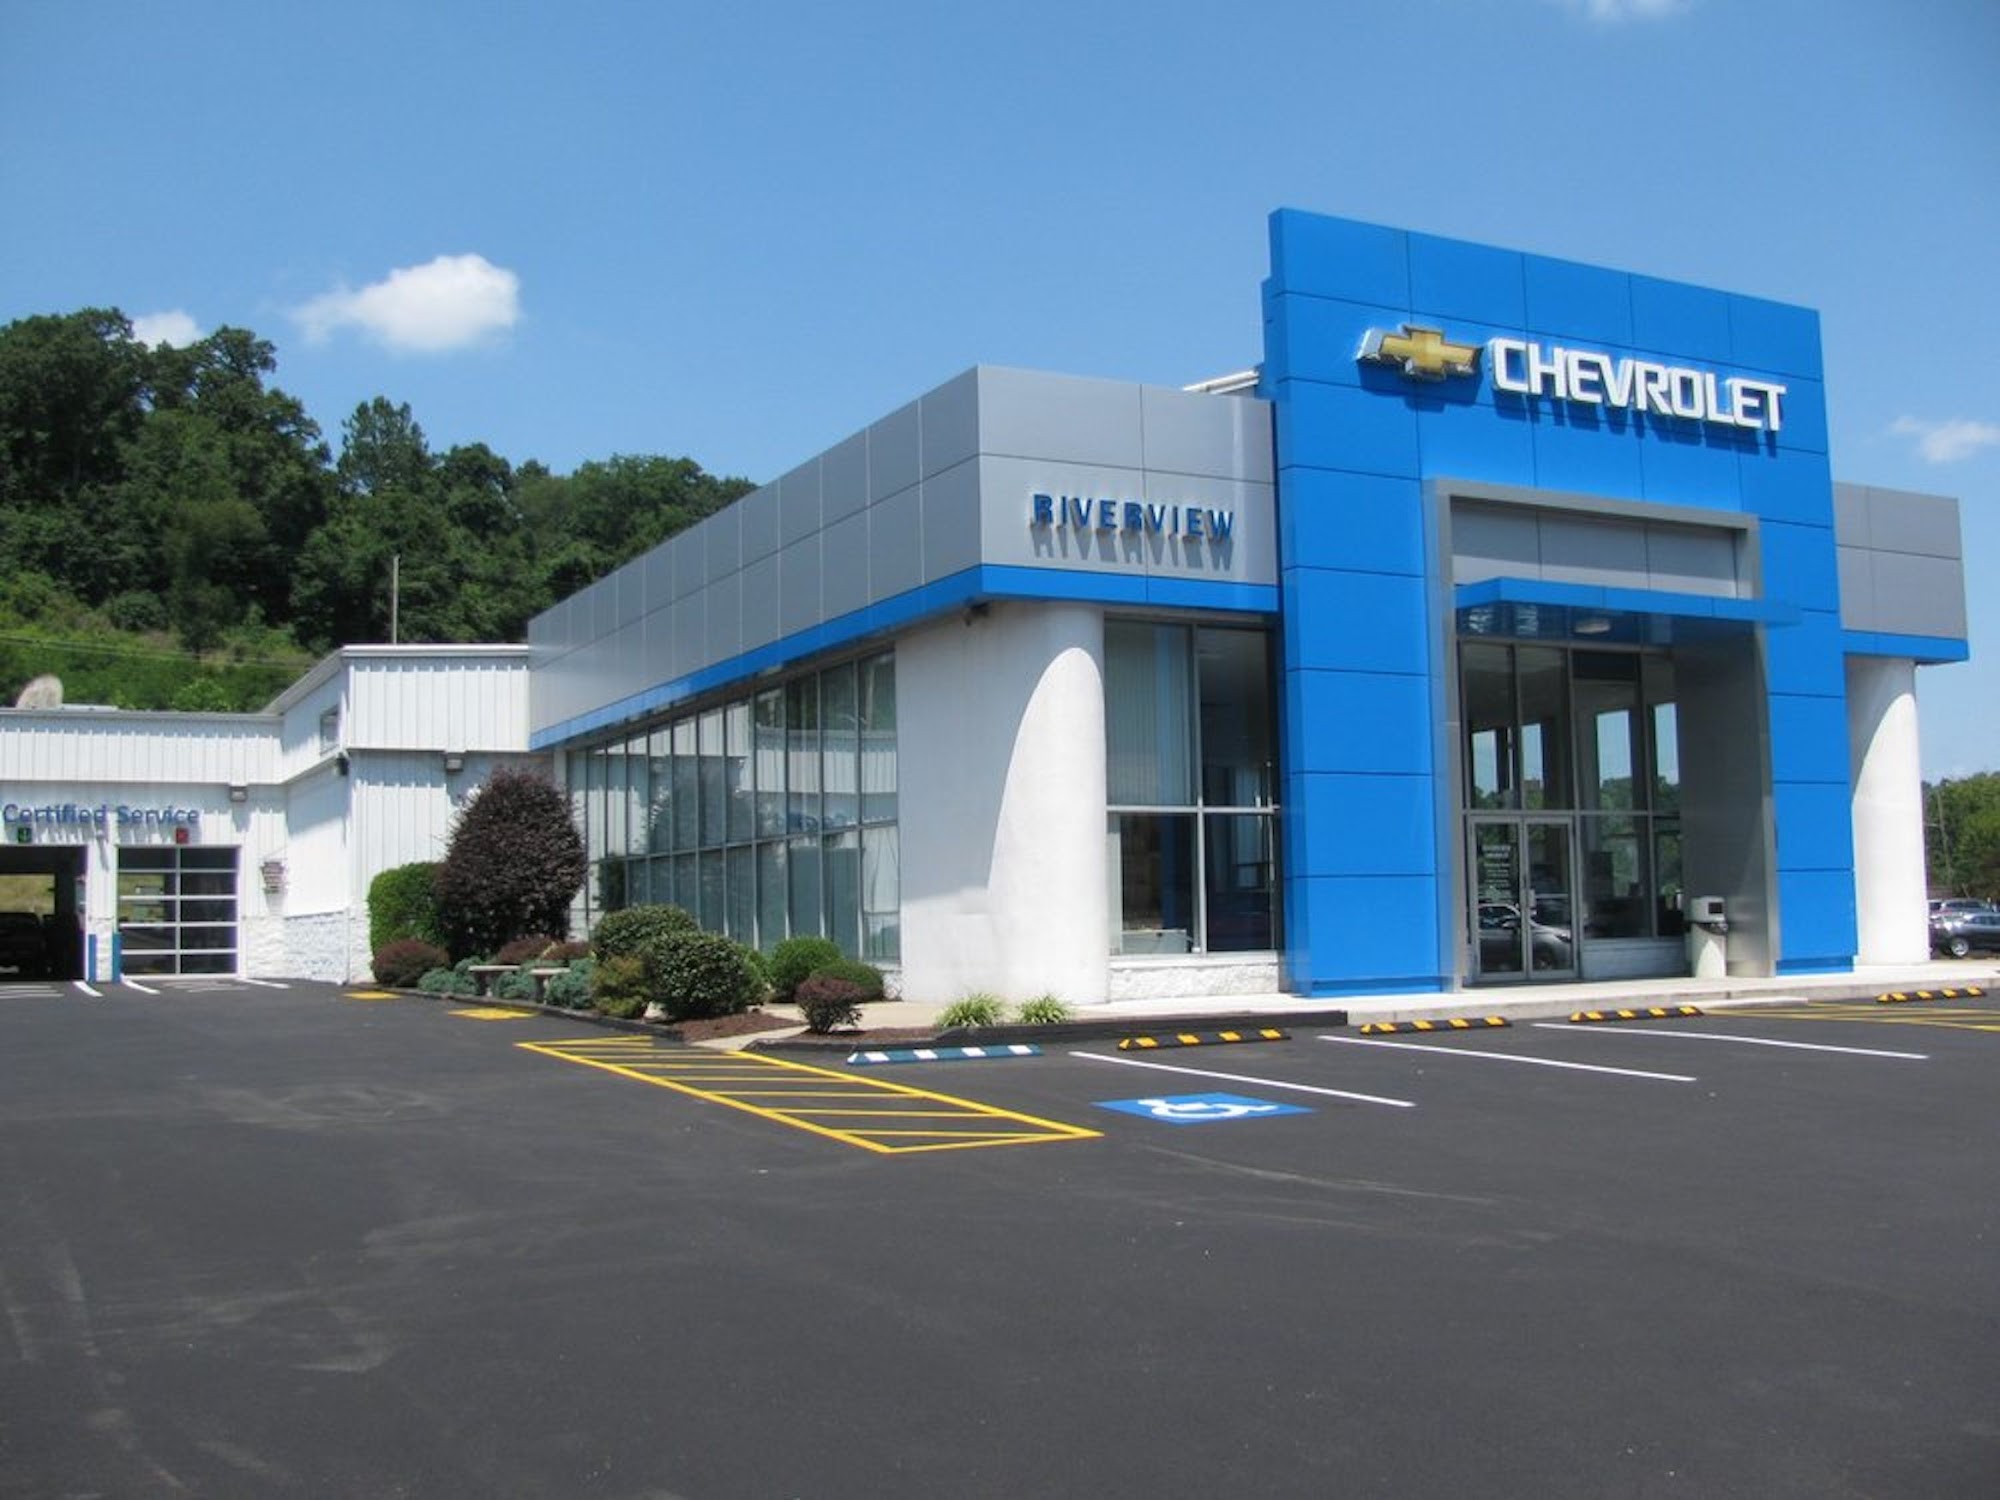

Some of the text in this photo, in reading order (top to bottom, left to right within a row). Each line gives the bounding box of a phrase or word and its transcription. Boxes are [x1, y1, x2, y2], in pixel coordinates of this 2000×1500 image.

[1489, 337, 1786, 431] CHEVROLET
[1033, 494, 1233, 540] RIVERVIEW
[3, 804, 199, 824] Certified Service
